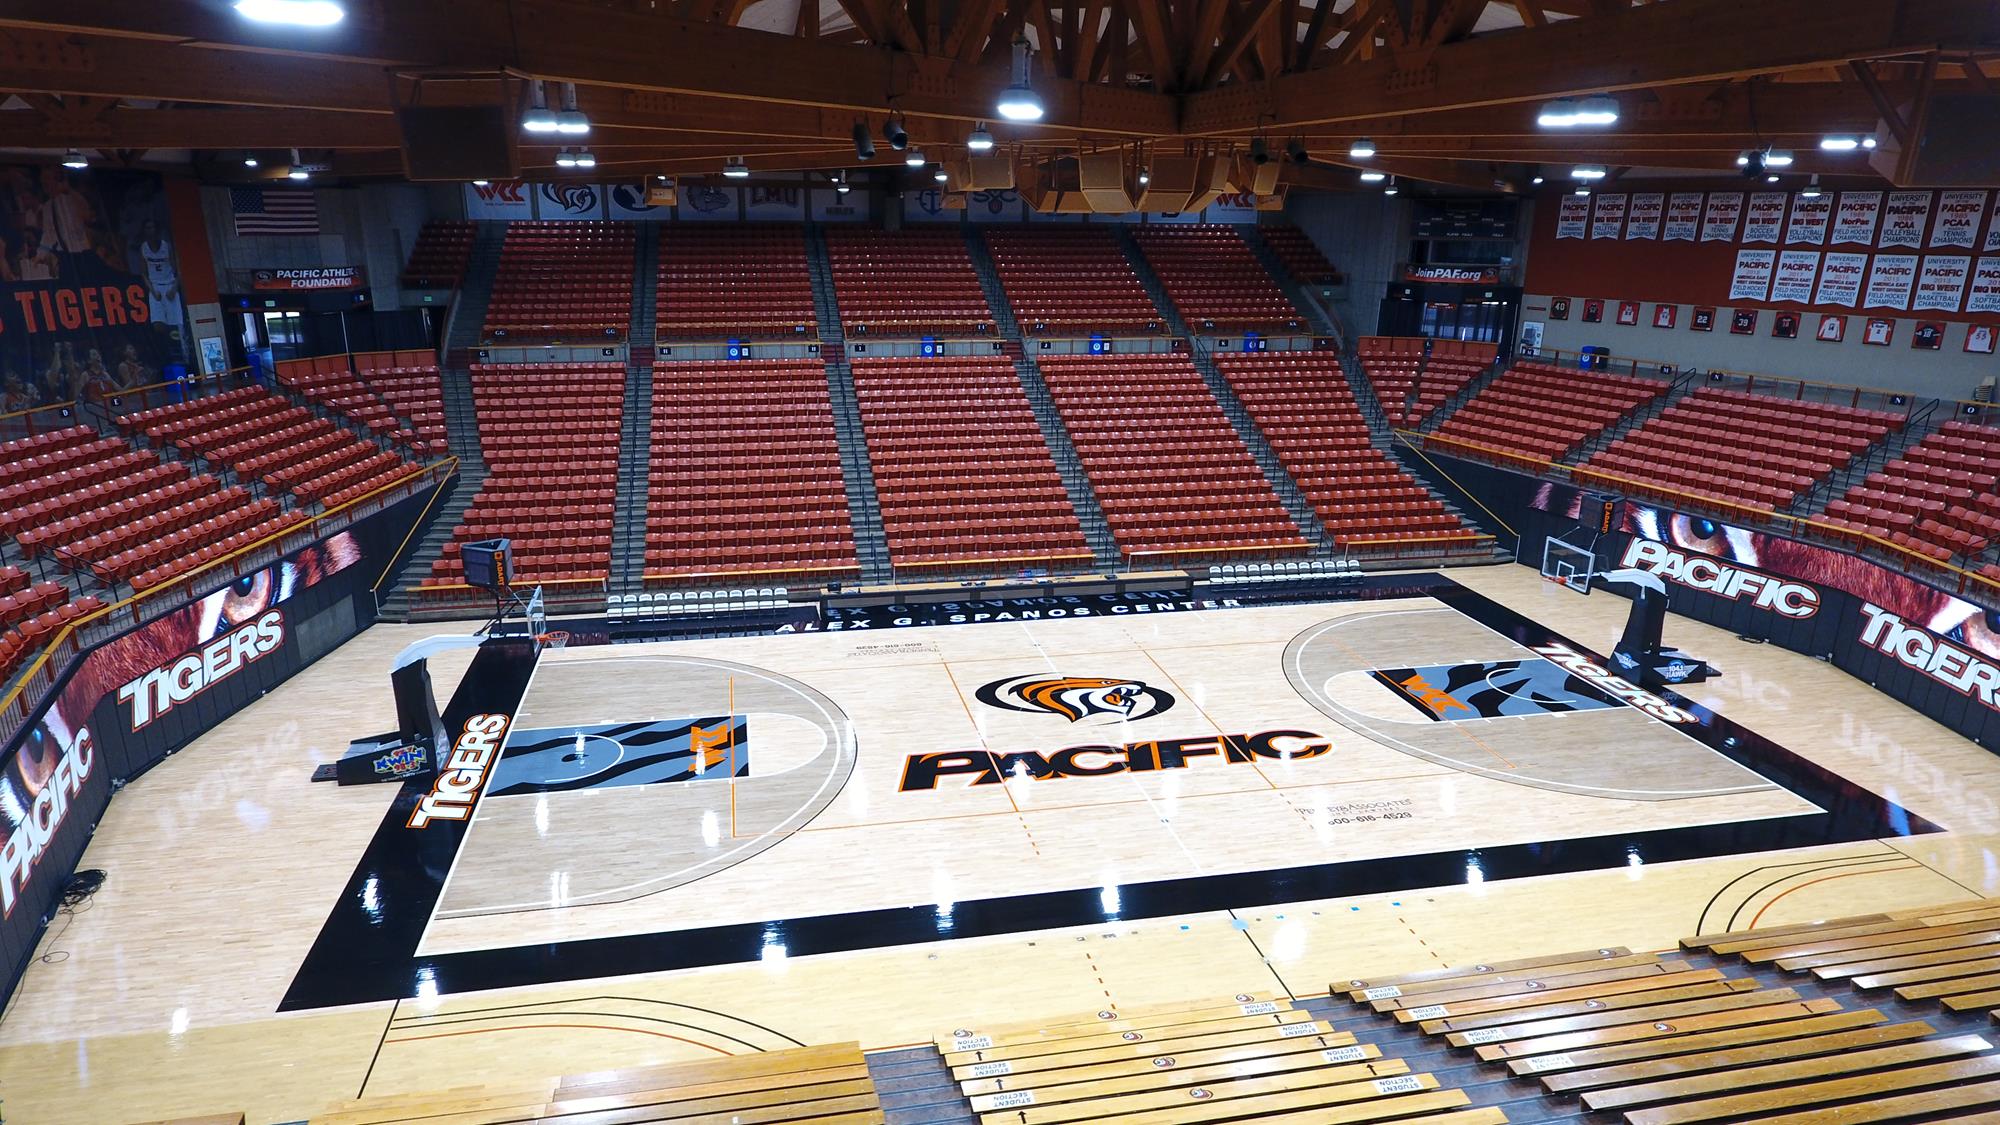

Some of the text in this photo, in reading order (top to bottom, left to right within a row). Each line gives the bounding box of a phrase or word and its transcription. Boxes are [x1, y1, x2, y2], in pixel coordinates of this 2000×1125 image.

[1891, 194, 1928, 202] UNIVERSITY
[1671, 203, 1699, 211] PACIFIC
[1752, 203, 1782, 211] PACIFIC
[1795, 204, 1829, 212] PACIFIC
[1887, 206, 1926, 215] PACIFIC
[1941, 204, 1980, 213] PACIFIC
[1943, 219, 1970, 227] PCAA
[1933, 236, 1973, 244] CHAMPIONS
[1781, 263, 1814, 272] PACIFIC
[1826, 265, 1861, 274] PACIFIC
[1875, 267, 1911, 275] PACIFIC
[277, 269, 320, 279] PACIFIC
[1416, 267, 1481, 282] JoinPAF.org
[1925, 268, 1963, 277] PACIFIC
[14, 283, 149, 334] TIGERS
[1619, 536, 1820, 618] PACIFIC
[775, 599, 1241, 633] ALEX G. SPANOS CENTER
[1859, 601, 2000, 713] TIGER
[118, 608, 286, 732] TIGERS
[1529, 641, 1700, 724] TIGERS
[375, 748, 426, 771] KWIN
[898, 729, 1334, 793] PACIFIC
[405, 712, 510, 829] TIGERS
[0, 725, 94, 920] PACIFIC
[1371, 991, 1399, 999] STUDENT
[1284, 1028, 1316, 1036] STUDENT
[958, 1042, 990, 1050] STUDENT
[1330, 1053, 1363, 1061] STUDENT
[1379, 1077, 1414, 1086] SECTION
[1382, 1083, 1420, 1093] STUDENT
[993, 1092, 1028, 1100] SECTION
[994, 1098, 1031, 1107] STUDENT
